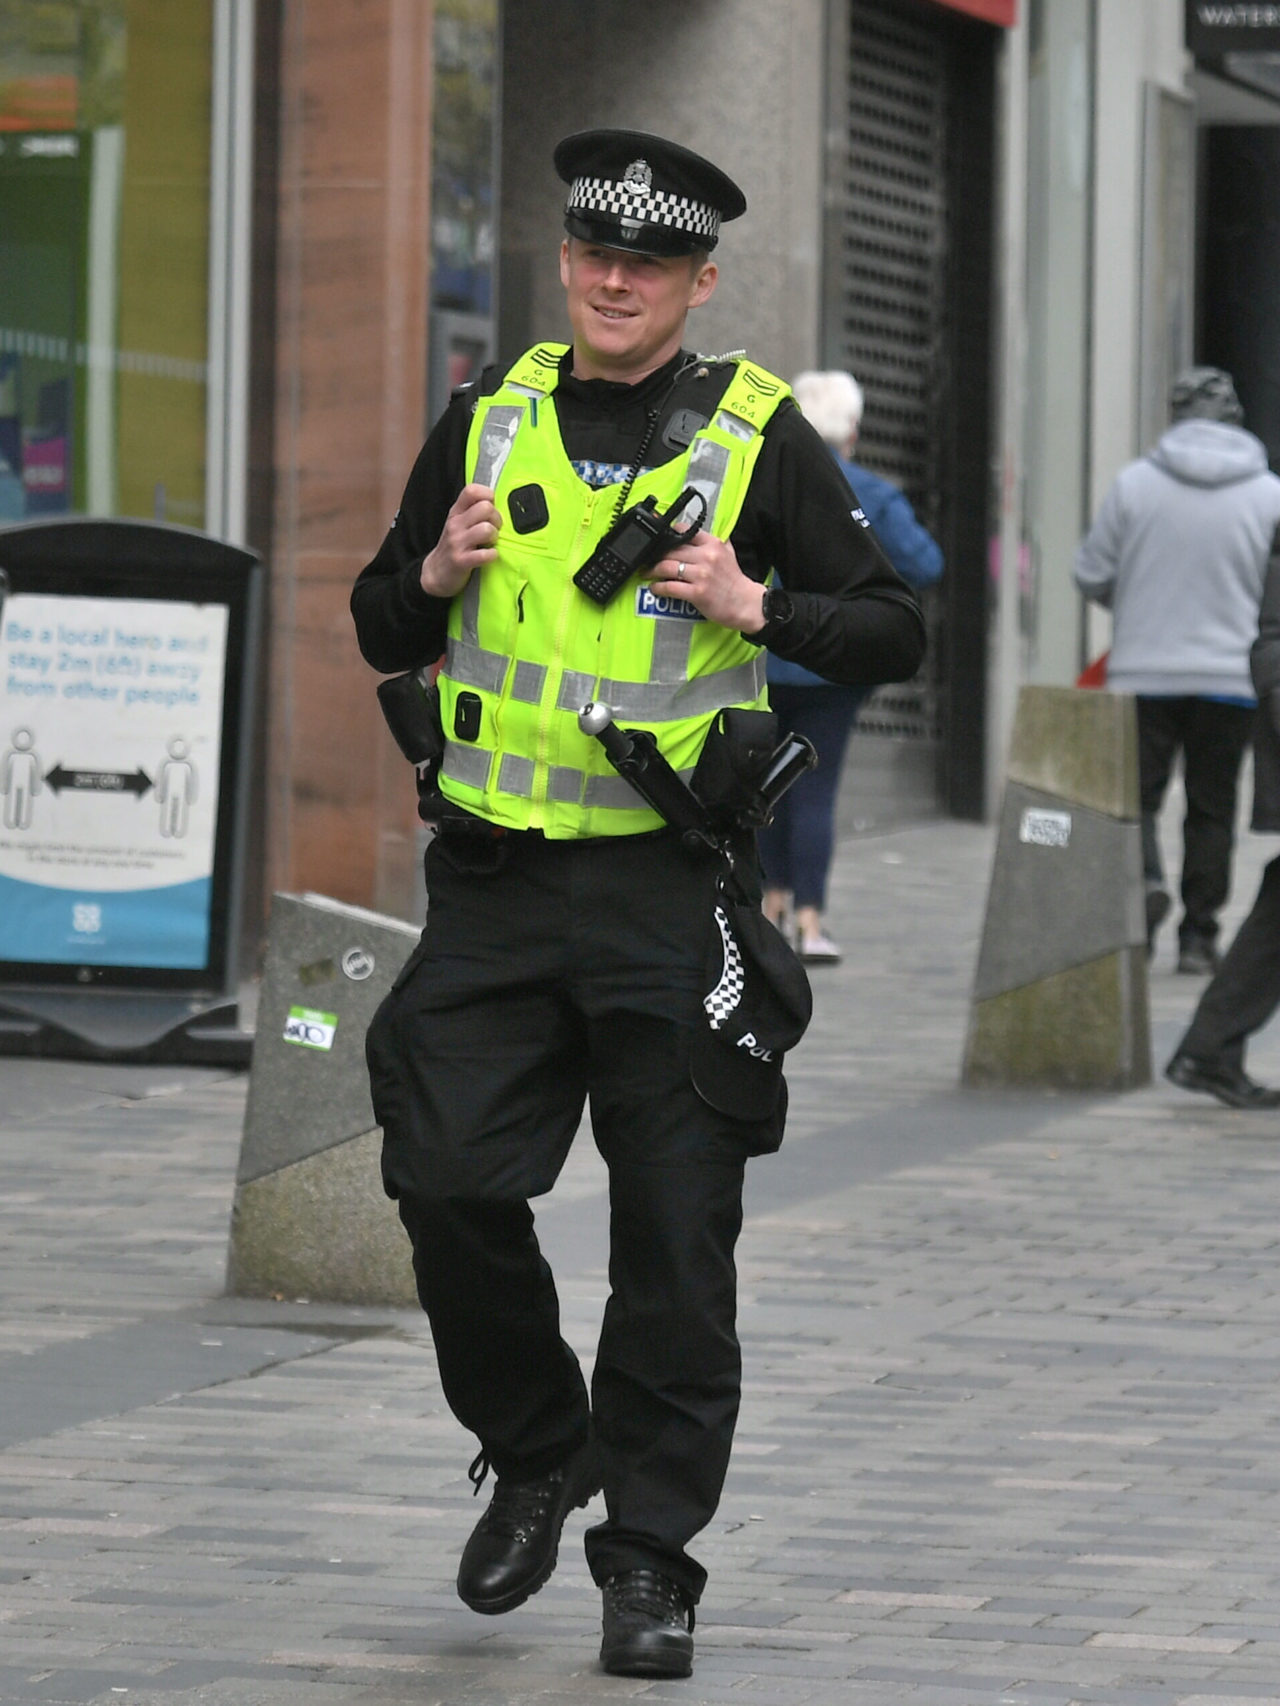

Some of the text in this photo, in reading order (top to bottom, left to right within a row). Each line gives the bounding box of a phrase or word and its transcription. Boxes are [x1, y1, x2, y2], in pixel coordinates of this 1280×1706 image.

[1197, 3, 1280, 28] WATER
[747, 394, 756, 404] G
[642, 591, 700, 616] POLIC
[6, 622, 34, 643] Be
[57, 623, 109, 646] local
[114, 627, 163, 649] hero
[8, 651, 52, 675] stay
[58, 652, 93, 672] 2m
[146, 661, 202, 684] away
[7, 674, 201, 709] from other people
